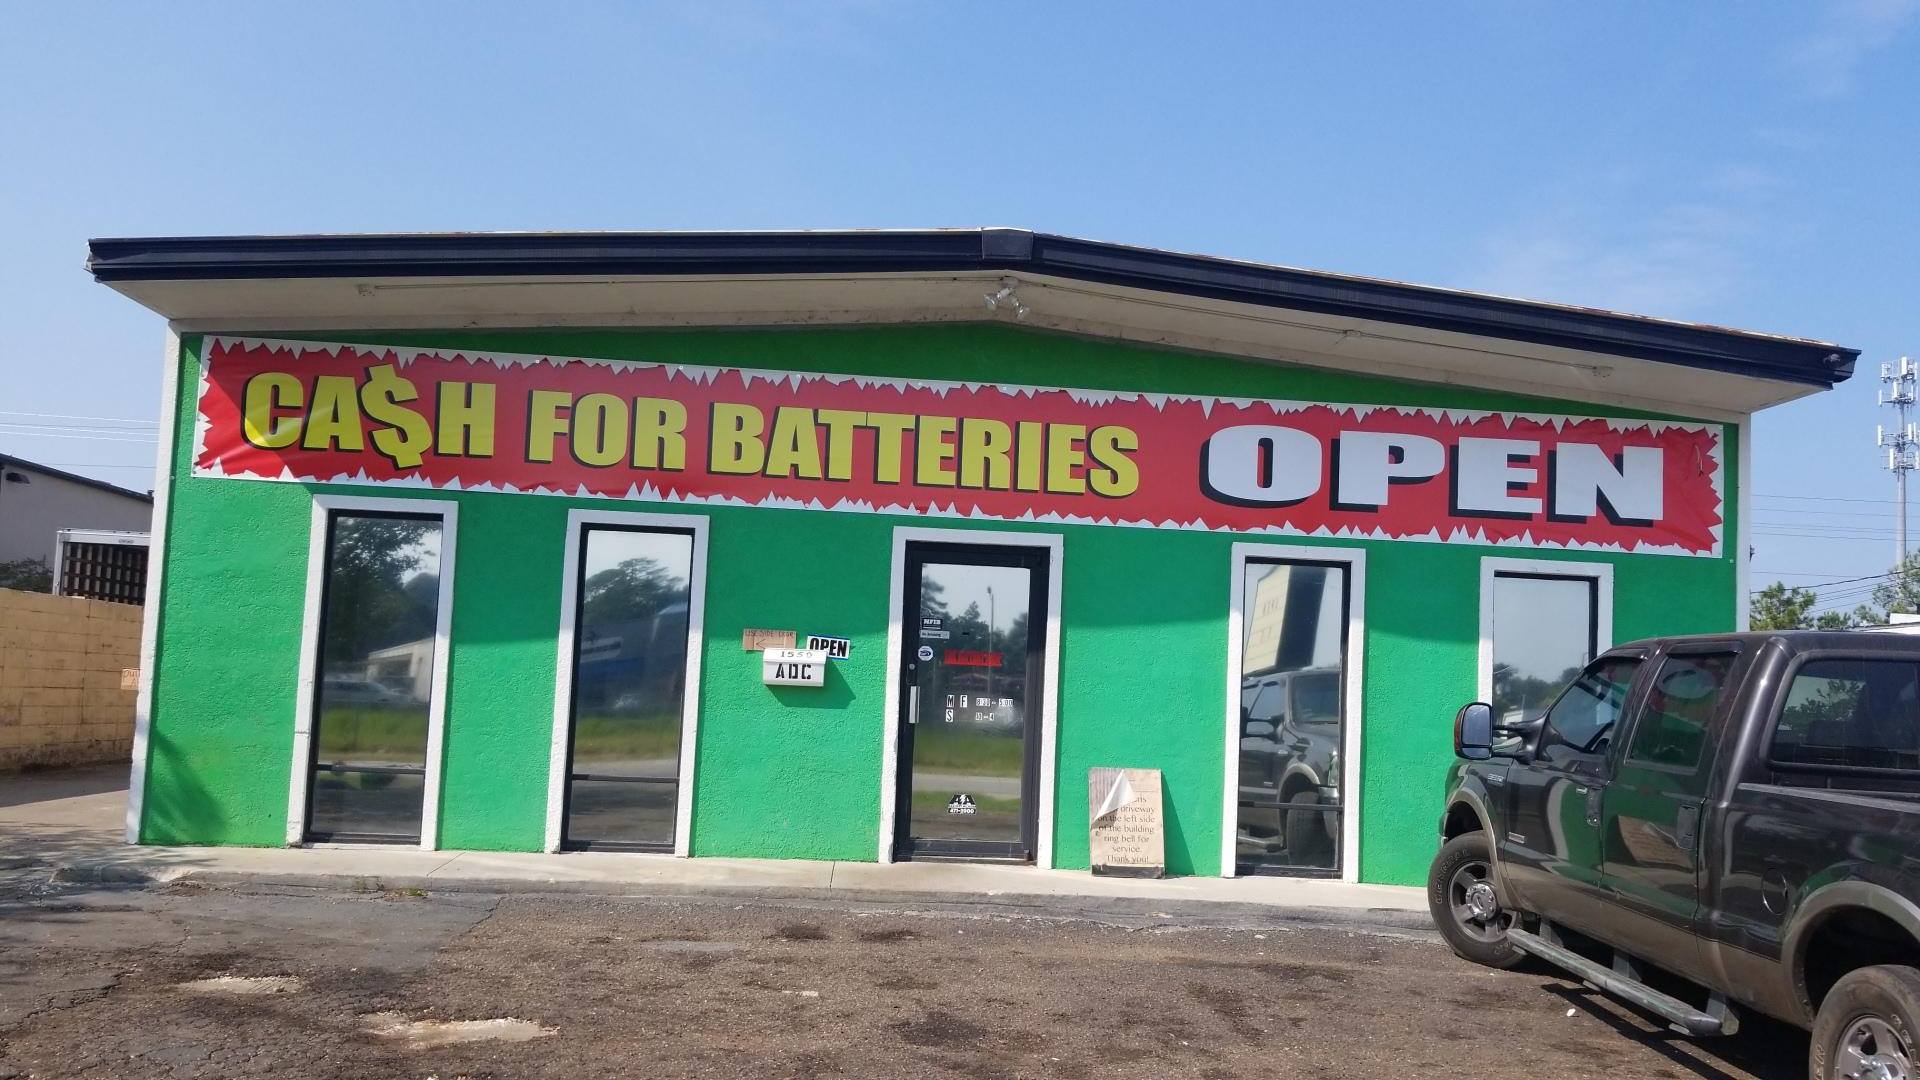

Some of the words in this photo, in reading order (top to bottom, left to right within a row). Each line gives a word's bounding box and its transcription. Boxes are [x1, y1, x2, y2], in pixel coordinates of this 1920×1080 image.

[241, 363, 496, 471] CA$H
[524, 389, 688, 471] FOR
[706, 401, 1140, 498] BATTERIES
[1199, 424, 1664, 528] OPEN
[809, 637, 848, 658] OPEN
[775, 663, 812, 680] ADC
[947, 694, 954, 708] M
[961, 695, 967, 708] F
[946, 709, 953, 722] S
[1121, 806, 1154, 815] driveway
[1110, 814, 1122, 822] the
[1124, 825, 1154, 834] building
